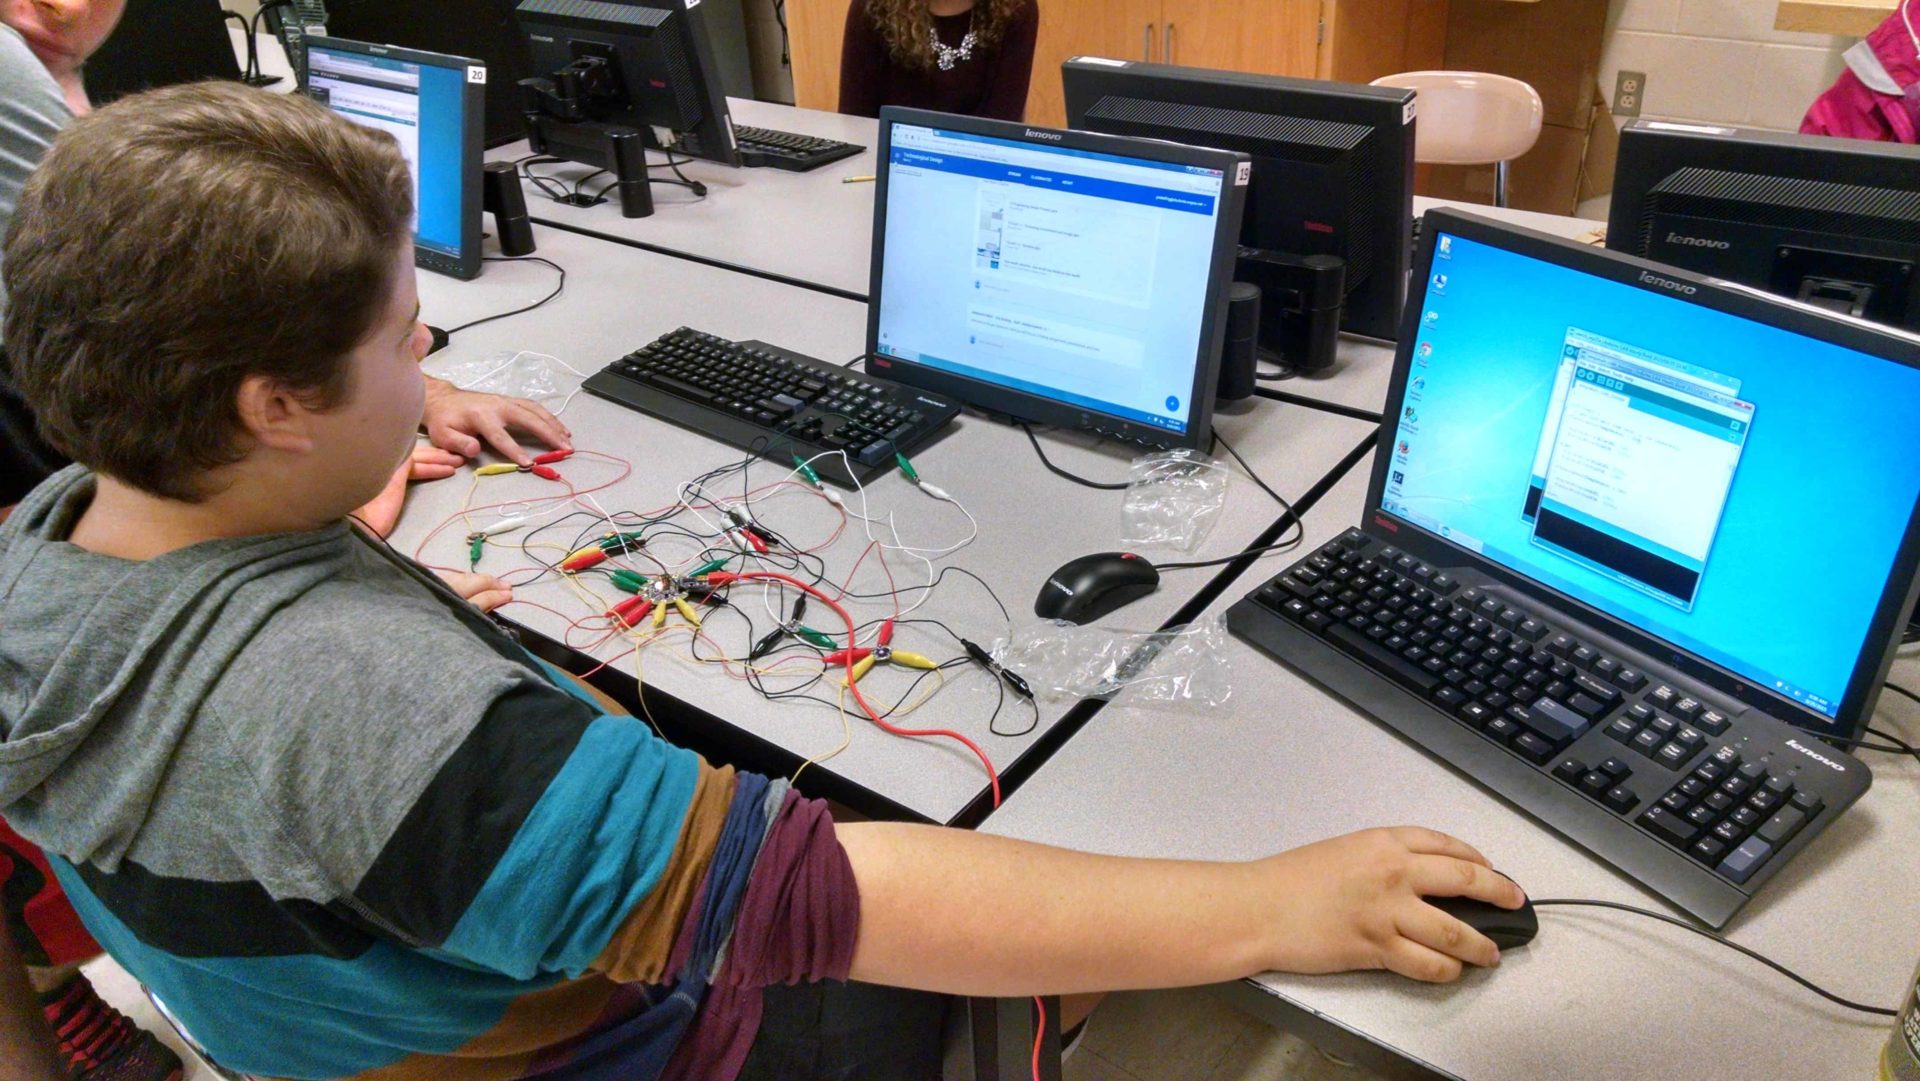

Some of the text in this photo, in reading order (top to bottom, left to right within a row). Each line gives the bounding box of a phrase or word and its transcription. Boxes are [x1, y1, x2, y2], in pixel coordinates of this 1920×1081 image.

[471, 69, 483, 80] 20
[1025, 128, 1062, 141] lenovo
[1239, 168, 1249, 181] 19
[1665, 232, 1730, 249] lenovo
[1638, 271, 1697, 295] lenovo
[1785, 740, 1845, 771] lenovo
